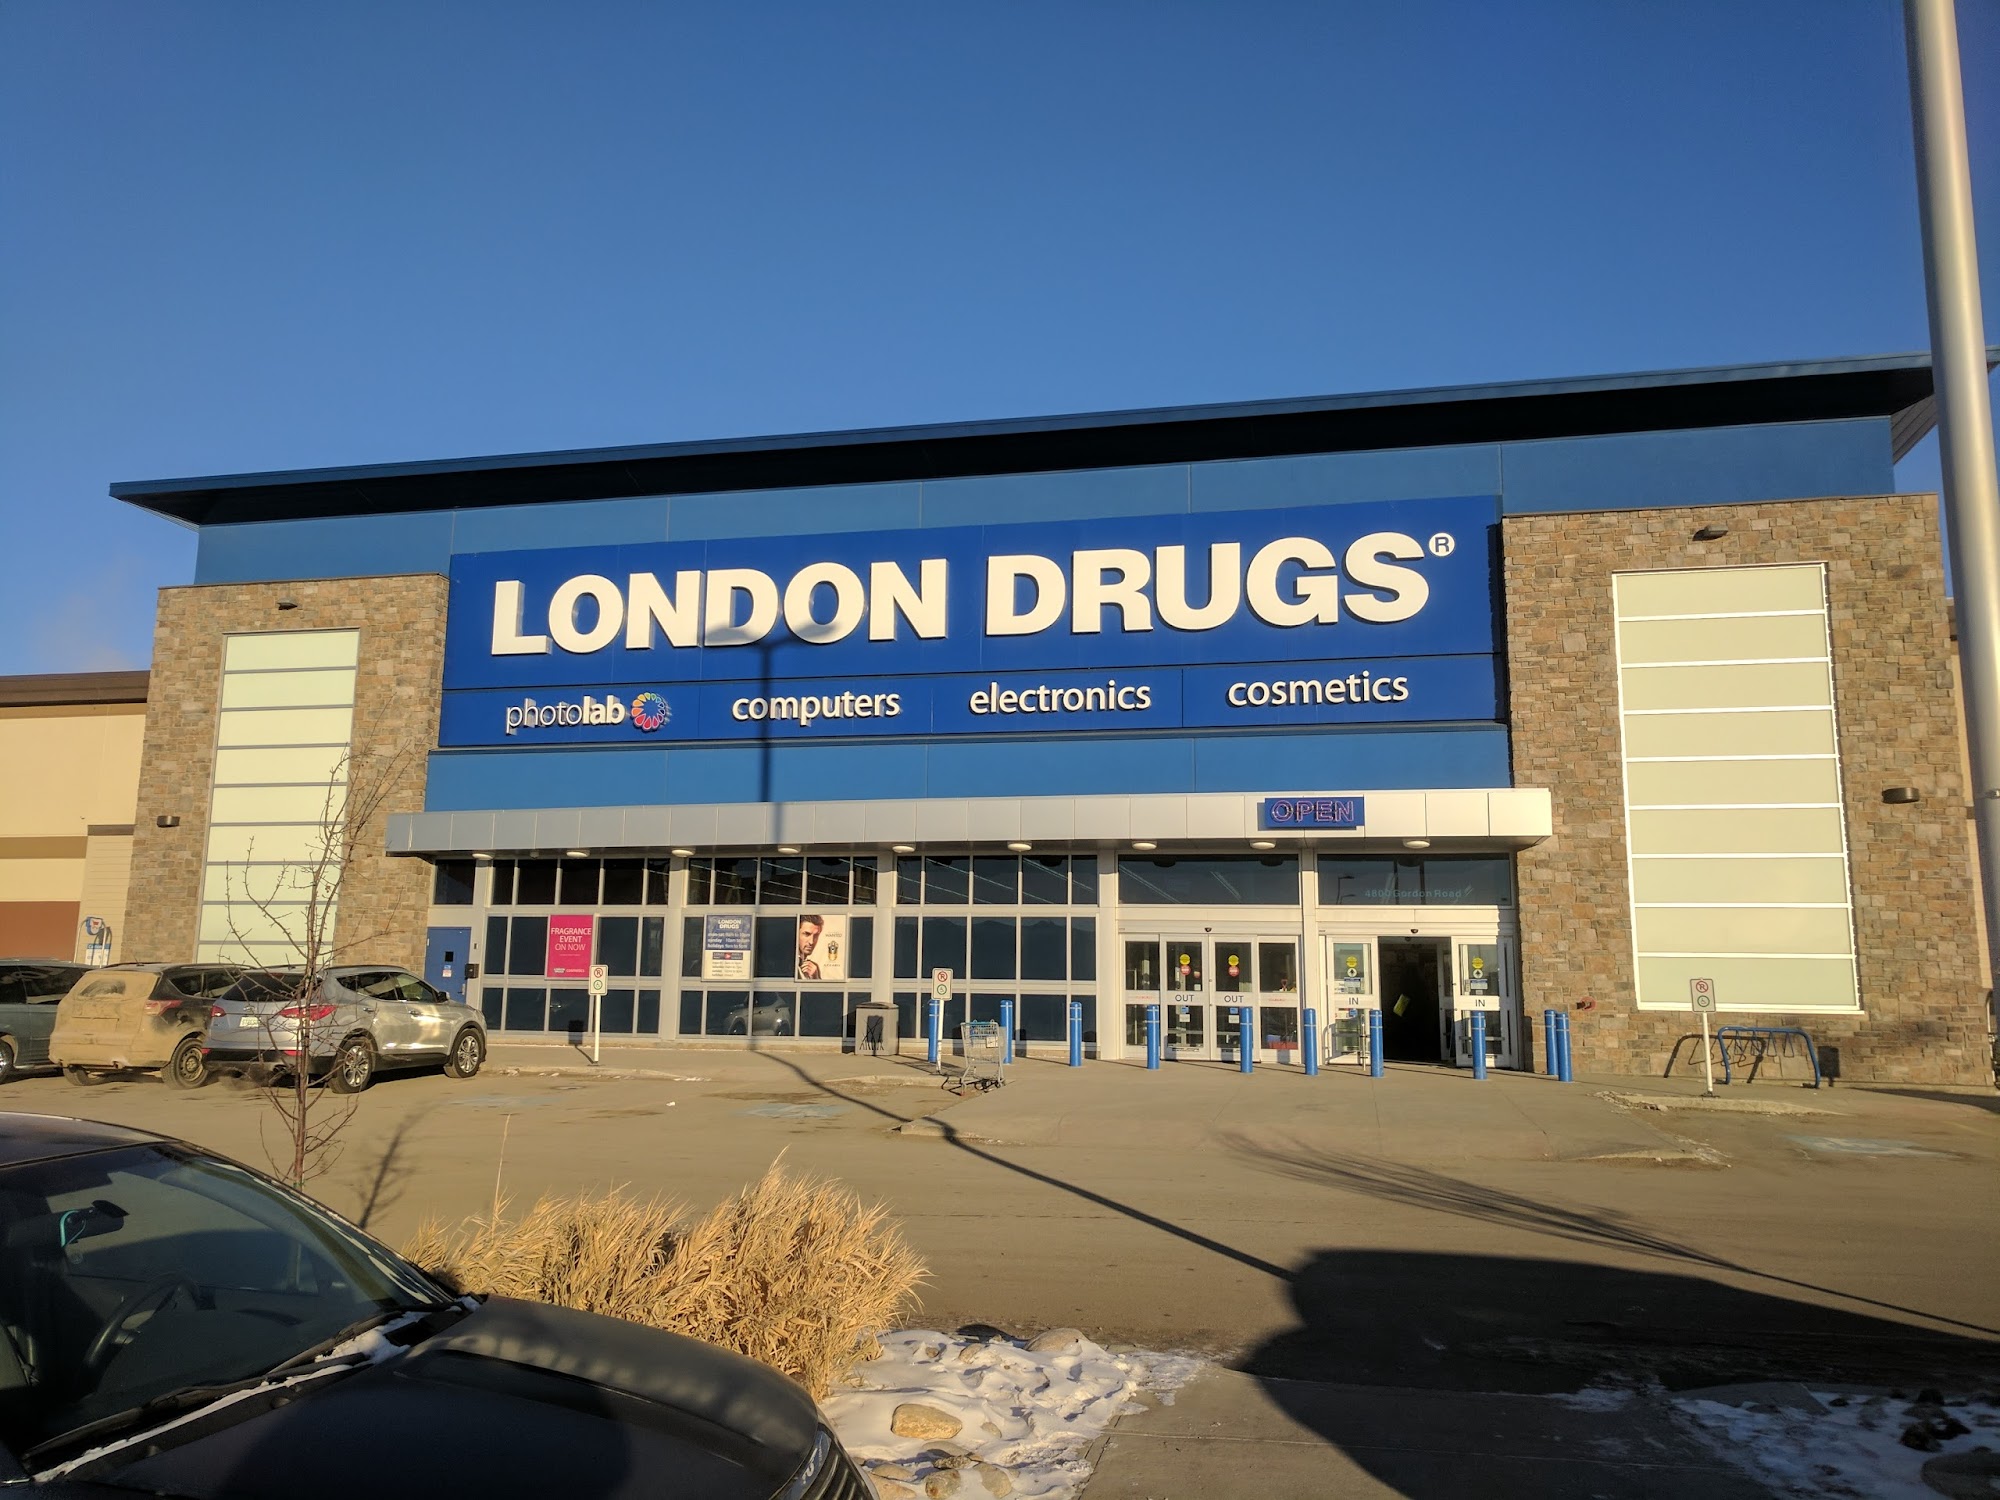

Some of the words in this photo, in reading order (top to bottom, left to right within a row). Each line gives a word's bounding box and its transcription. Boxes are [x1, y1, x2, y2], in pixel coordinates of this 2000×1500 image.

[491, 558, 949, 655] LONDON
[985, 532, 1430, 636] DRUGS
[1227, 670, 1409, 706] cosmetics
[969, 679, 1151, 714] electronics
[732, 691, 902, 727] computers
[505, 695, 626, 735] photolab
[1272, 799, 1355, 822] OPEN
[1364, 889, 1391, 898] 4800
[1392, 889, 1432, 898] Gordon
[1434, 889, 1462, 898] Road
[551, 927, 592, 935] FRAGRANCE
[559, 935, 583, 943] EVENT
[554, 943, 567, 951] ON
[567, 943, 586, 951] NOW
[1175, 994, 1194, 1002] OUT
[1224, 995, 1244, 1003] OUT
[1348, 997, 1359, 1005] IN
[1475, 999, 1486, 1007] IN
